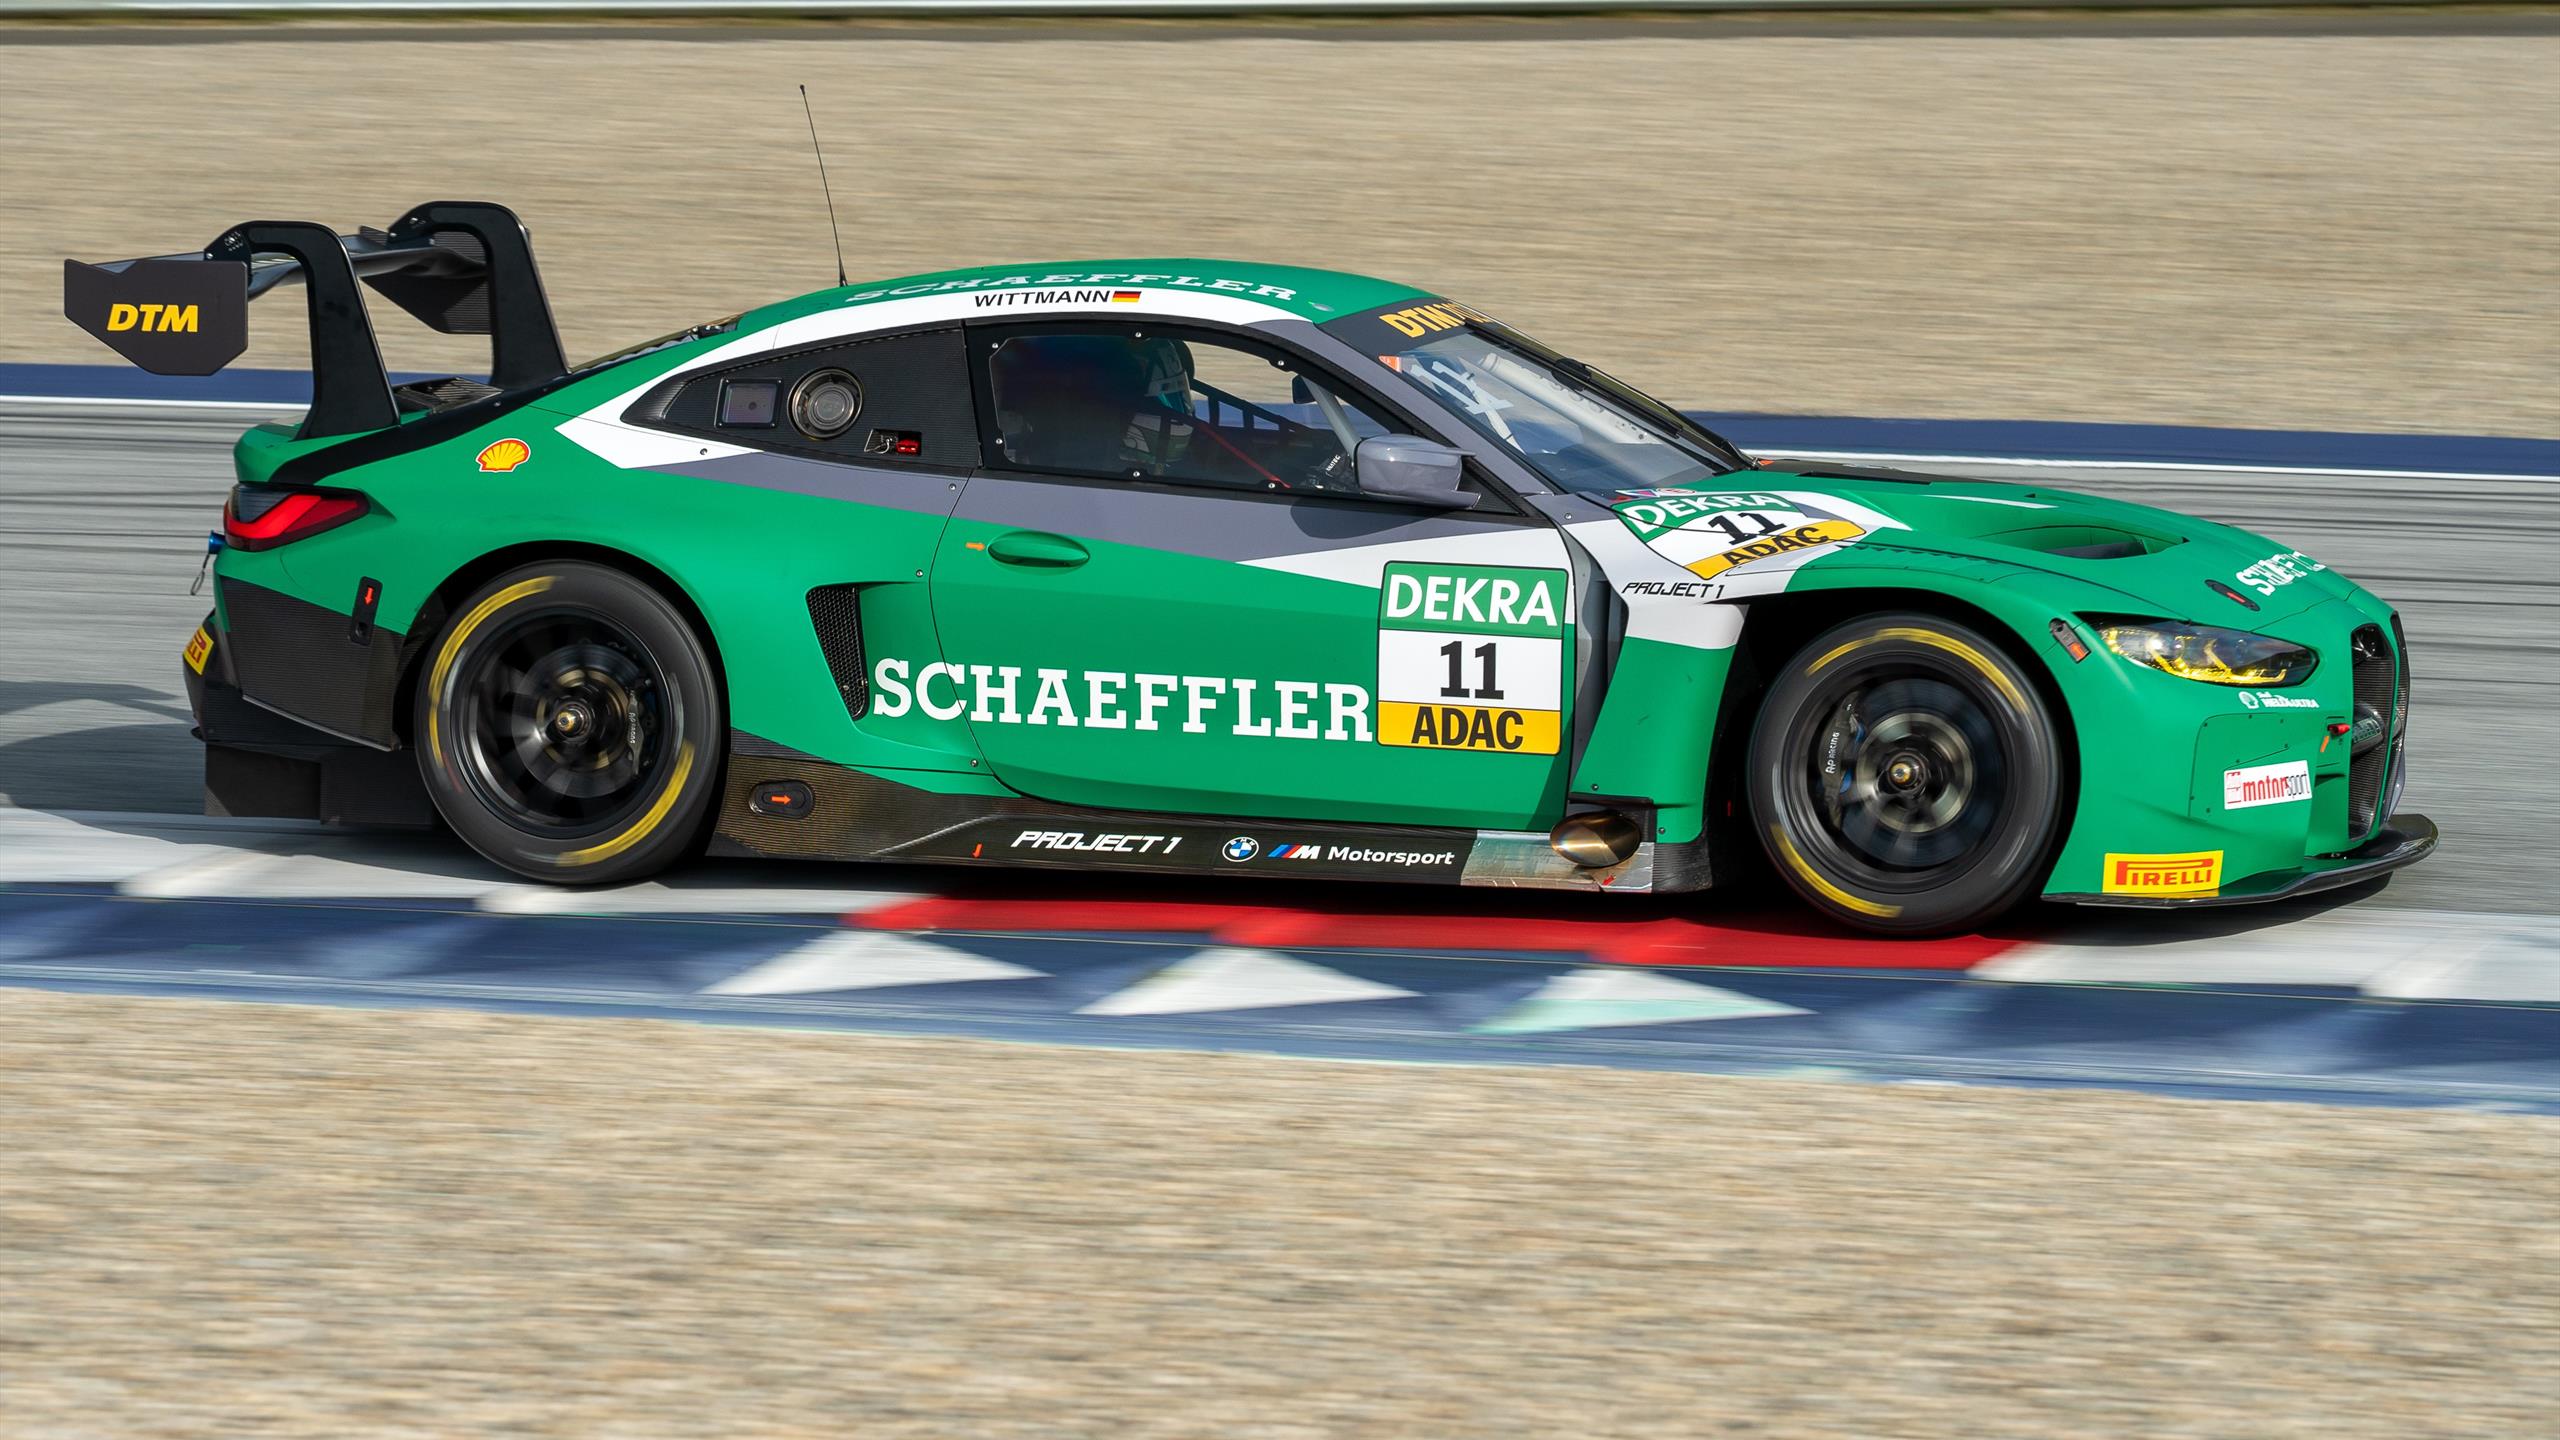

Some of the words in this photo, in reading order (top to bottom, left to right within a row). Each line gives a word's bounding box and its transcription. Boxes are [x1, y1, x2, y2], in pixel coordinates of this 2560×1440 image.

[847, 273, 1298, 302] SCHAEFFLER
[975, 290, 1111, 308] WITTMANN
[107, 303, 199, 333] DTM
[1621, 493, 1791, 535] DEKRA
[1707, 512, 1788, 546] 11
[1722, 526, 1829, 566] ADAC
[1386, 574, 1558, 627] DEKRA
[1621, 582, 1714, 598] PROJECT
[1715, 584, 1725, 599] 1
[1440, 640, 1505, 700] 11
[873, 657, 1374, 742] SCHAEFFLER
[1411, 705, 1524, 750] ADAC
[1010, 831, 1164, 852] PROJECT
[1162, 836, 1183, 854] 1
[1289, 844, 1332, 860] M
[1327, 846, 1455, 867] Motorsport
[2114, 858, 2214, 886] PIRELLI
